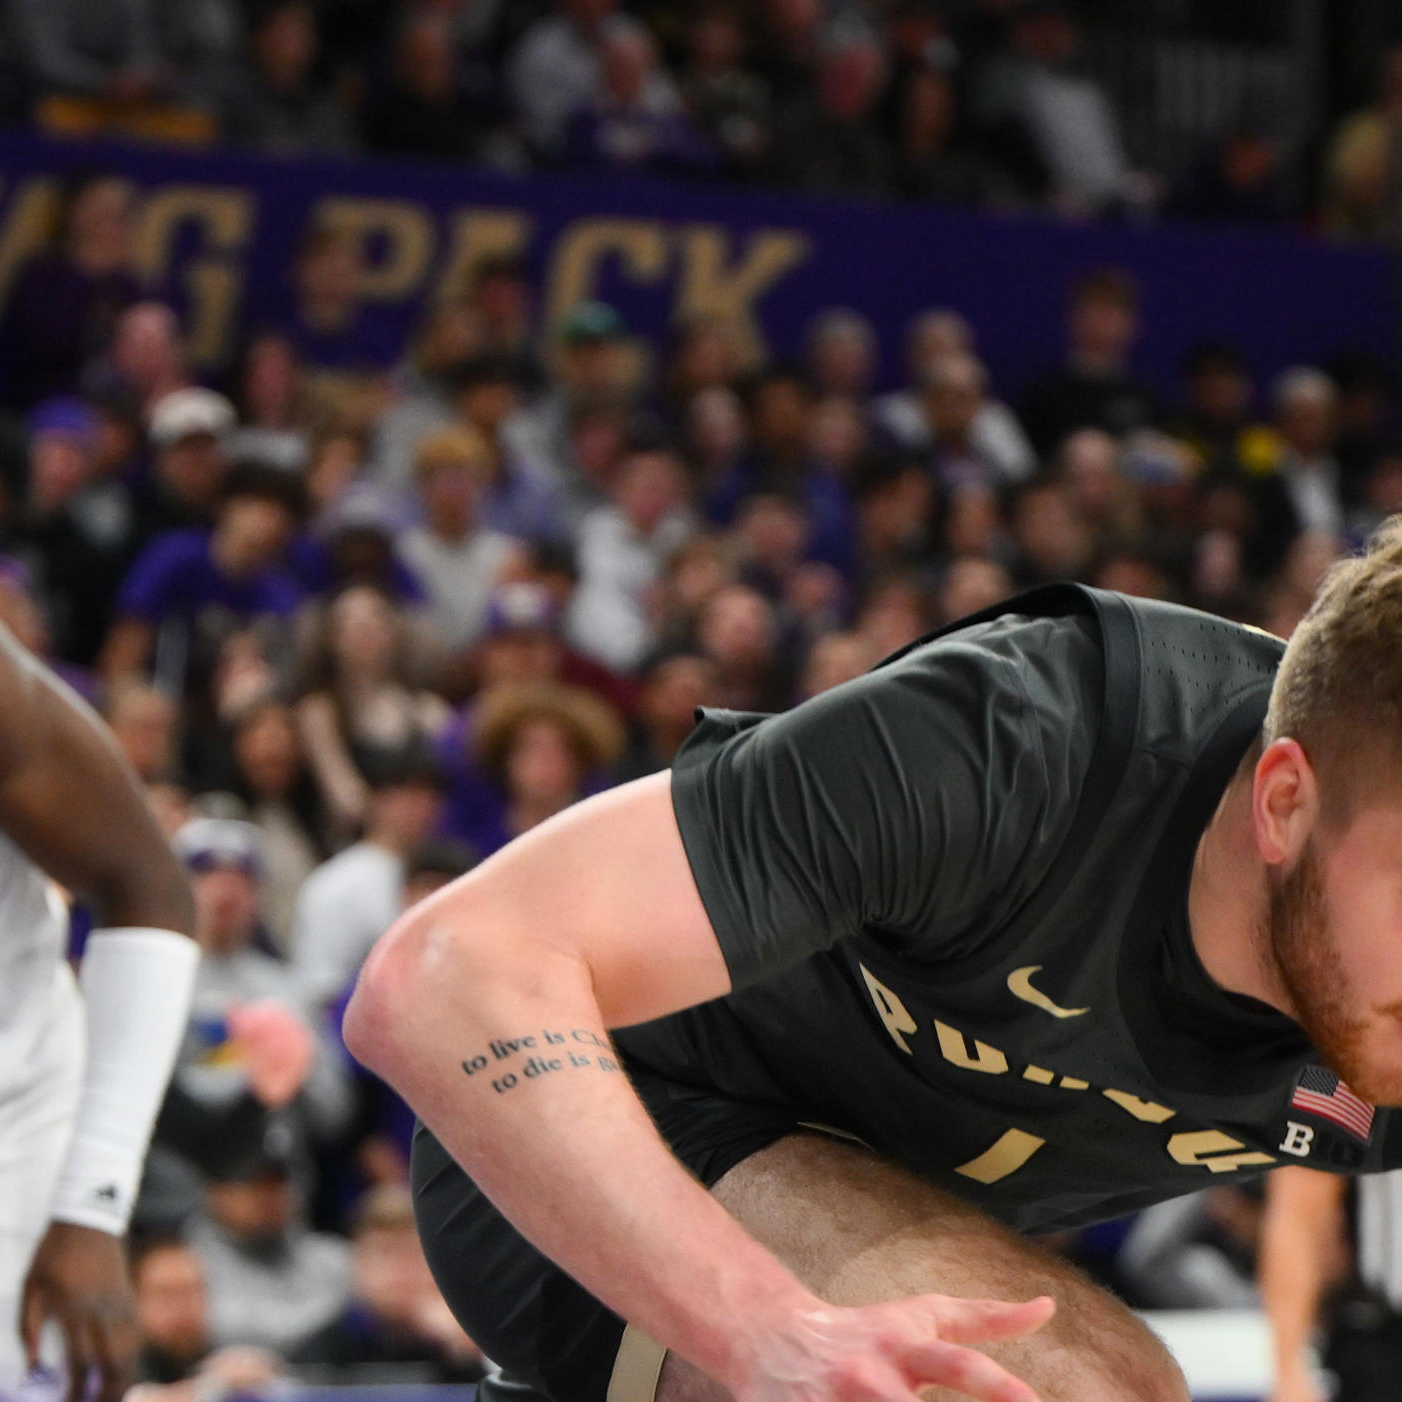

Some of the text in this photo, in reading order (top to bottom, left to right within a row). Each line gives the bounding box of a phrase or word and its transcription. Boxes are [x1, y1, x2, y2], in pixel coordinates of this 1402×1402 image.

[461, 1055, 488, 1077] to
[488, 1033, 538, 1060] live
[541, 1028, 566, 1045] is
[492, 1073, 518, 1095] to
[523, 1056, 563, 1079] die
[567, 1051, 592, 1068] is
